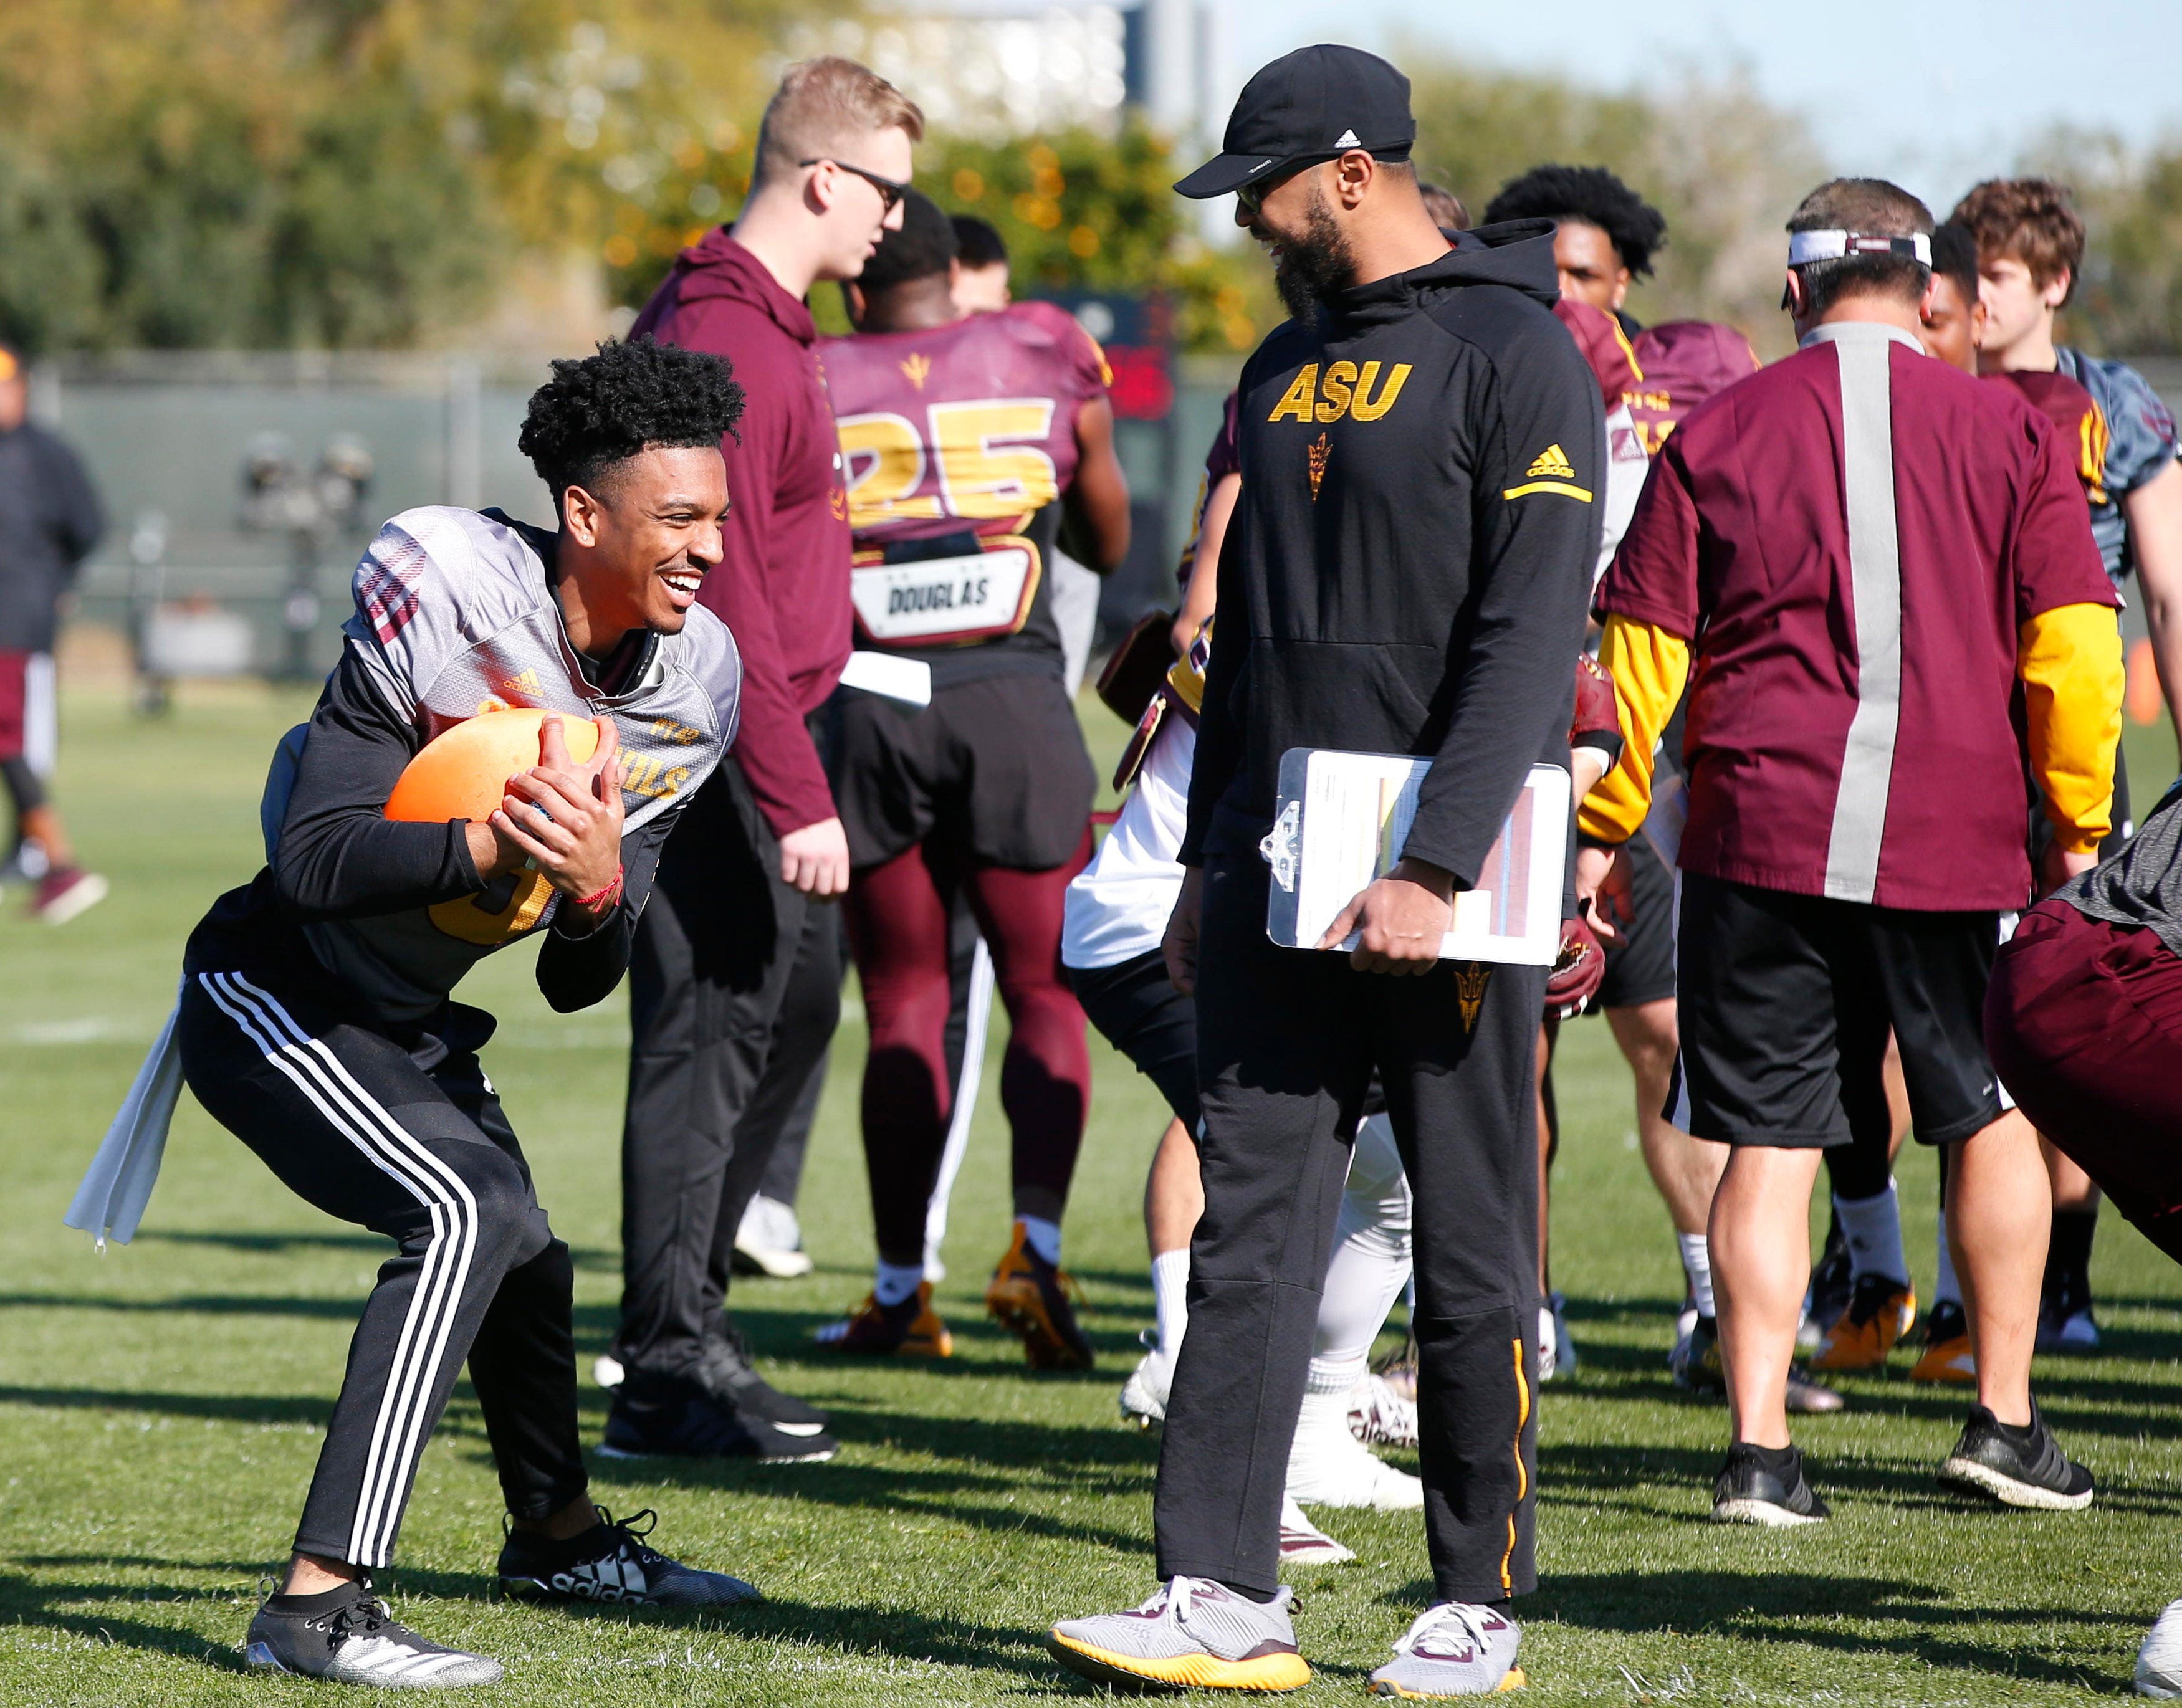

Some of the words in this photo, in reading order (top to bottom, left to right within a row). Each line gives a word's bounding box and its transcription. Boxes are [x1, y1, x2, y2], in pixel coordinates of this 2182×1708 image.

[1266, 360, 1414, 424] ASU
[836, 397, 1060, 528] 25
[1526, 465, 1576, 479] adidas
[889, 577, 989, 615] DOUGLAS
[503, 680, 544, 697] adidas
